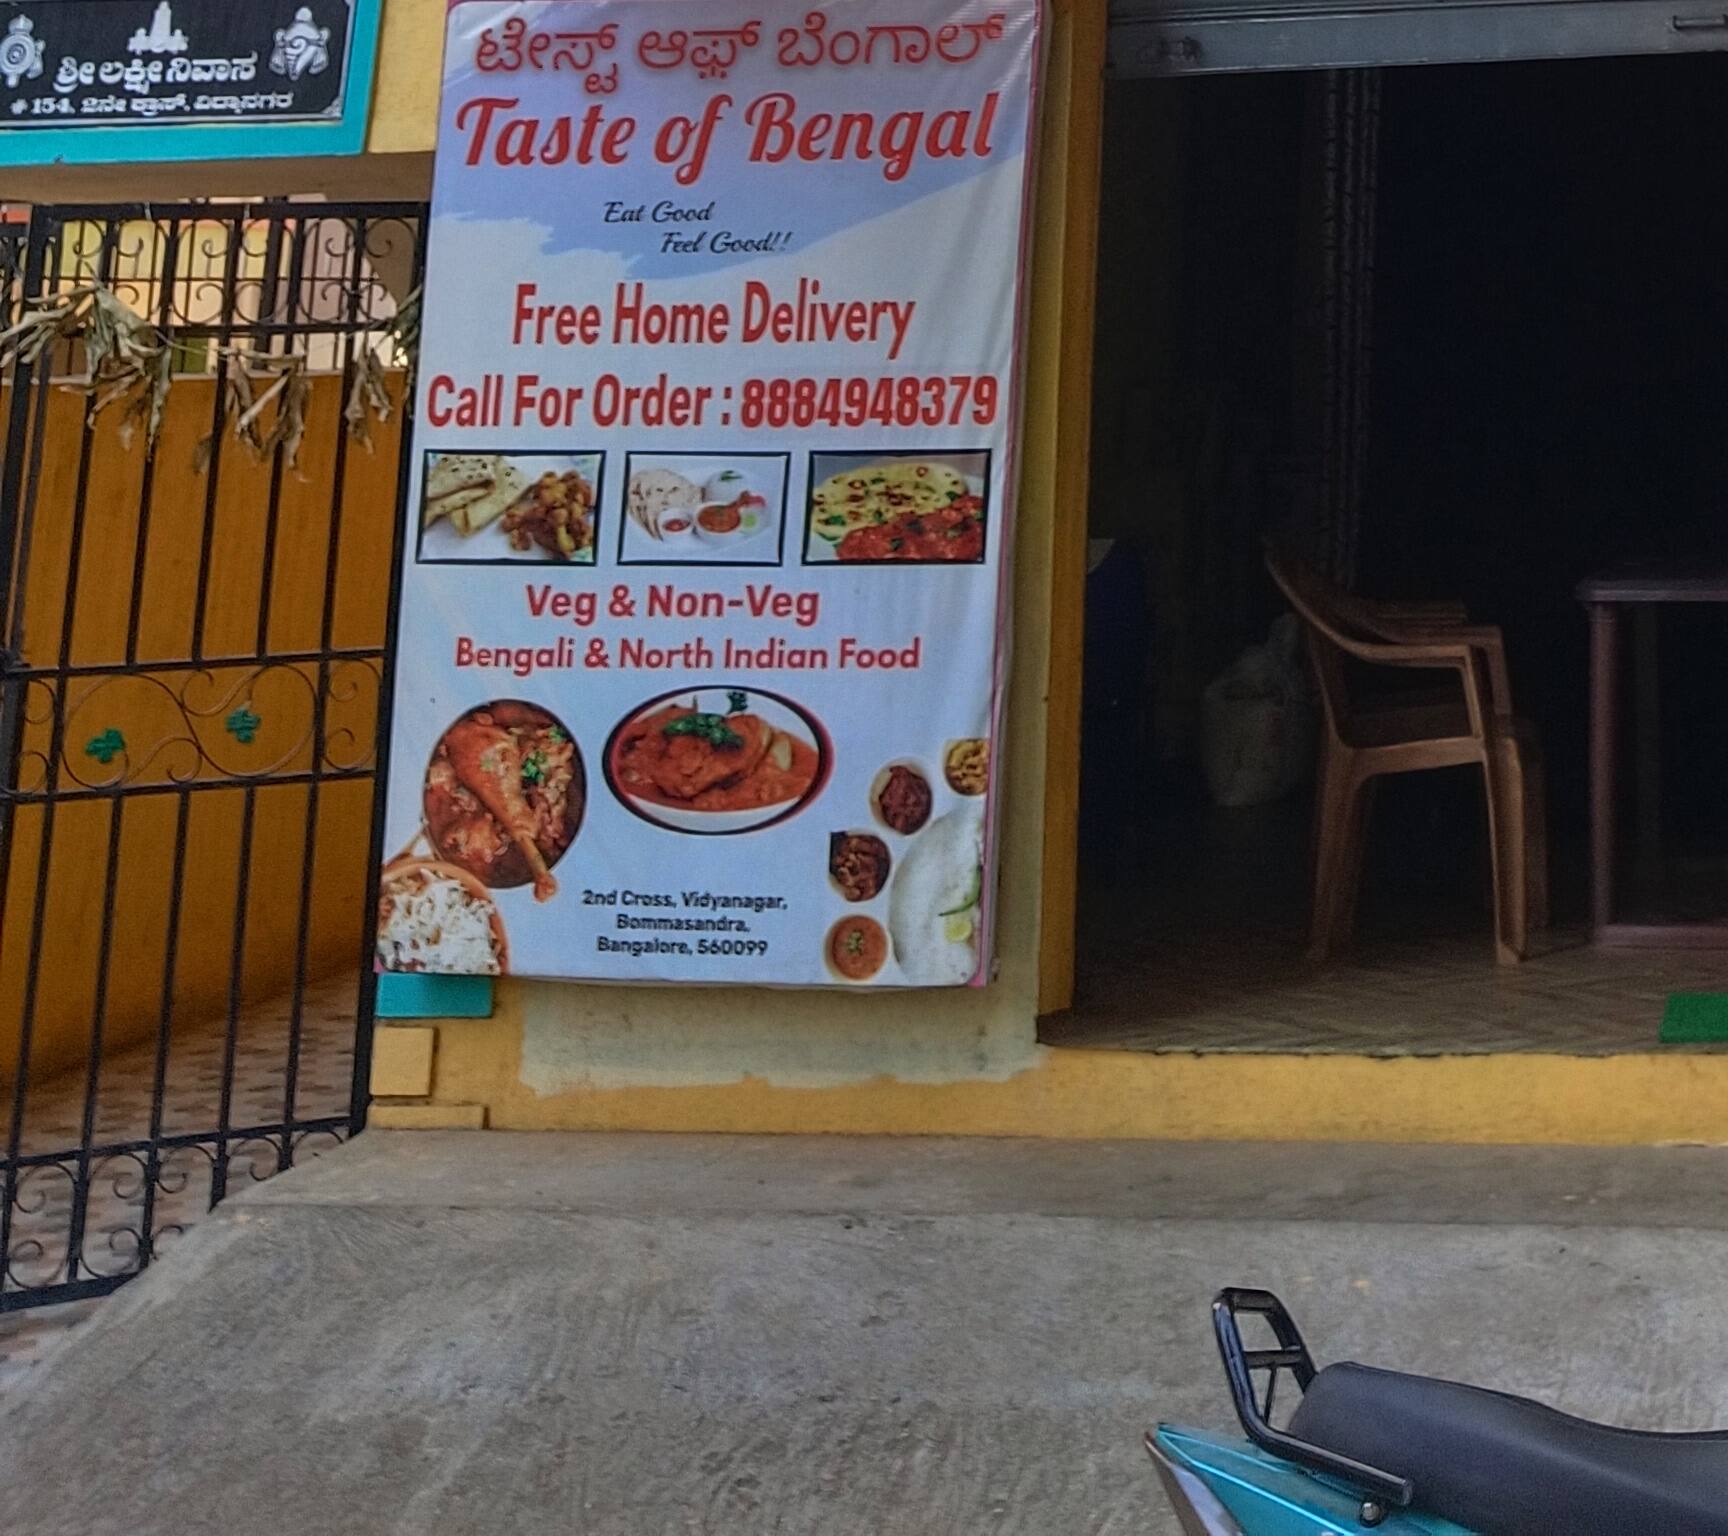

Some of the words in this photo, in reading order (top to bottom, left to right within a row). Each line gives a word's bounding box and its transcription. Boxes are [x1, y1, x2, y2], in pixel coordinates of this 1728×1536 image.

[53, 56, 95, 92] ಶ್ರೀ
[166, 52, 257, 82] ನಿವಾಸ
[457, 96, 636, 166] Taste
[655, 93, 732, 184] of
[745, 91, 999, 181] Bengal
[604, 201, 644, 224] Eat
[651, 201, 715, 224] Good
[660, 233, 703, 254] Feel
[710, 231, 792, 254] Good!!
[513, 283, 600, 344] Free
[613, 283, 728, 344] Home
[742, 278, 916, 360] Delivery
[427, 374, 501, 427] Call
[513, 374, 582, 426] For
[593, 374, 711, 426] Order
[741, 375, 998, 427] 8884948379
[526, 585, 599, 626] Veg
[609, 588, 636, 617] &
[648, 584, 819, 625] Non-Veg
[456, 638, 573, 677] Bengali
[584, 642, 609, 669] &
[620, 638, 713, 669] North
[725, 638, 827, 670] Indian
[839, 637, 920, 670] Food
[582, 889, 617, 905] 2nd
[622, 891, 677, 908] Cross,
[681, 891, 788, 912] Vidyanagar,
[617, 914, 750, 932] Bommasandra,
[597, 936, 692, 956] Bangalore,
[698, 939, 768, 955] 560099
